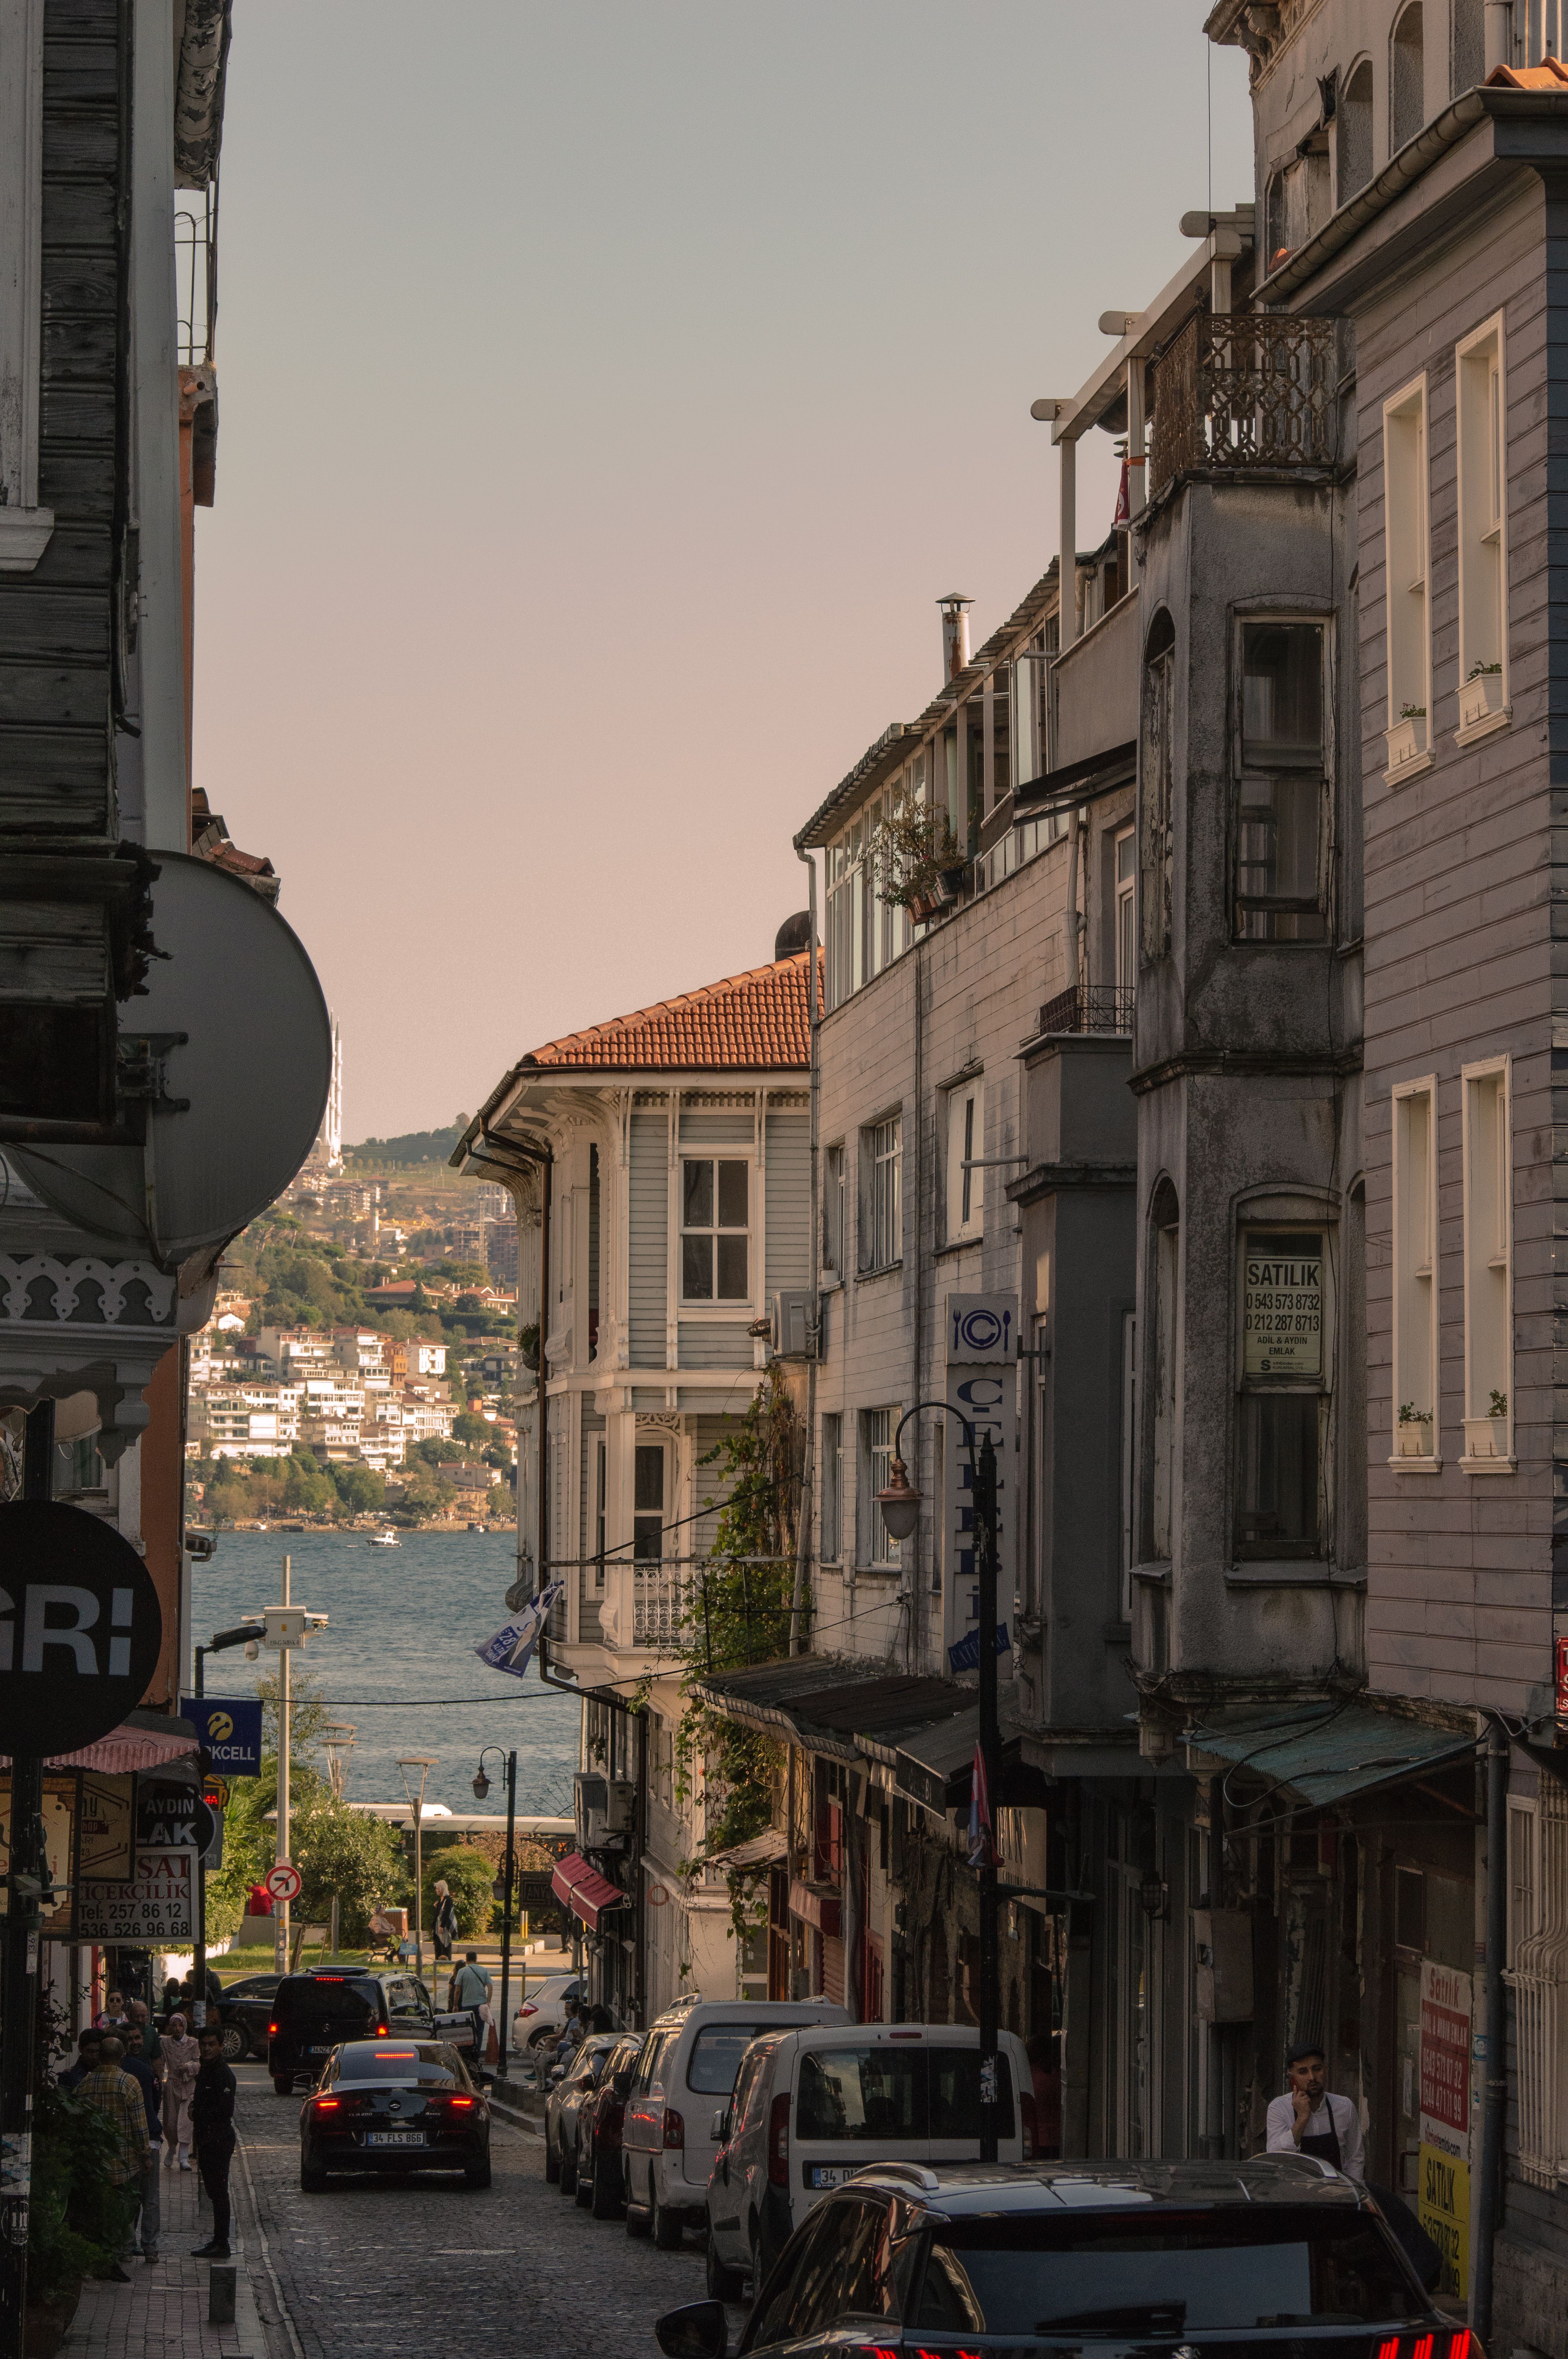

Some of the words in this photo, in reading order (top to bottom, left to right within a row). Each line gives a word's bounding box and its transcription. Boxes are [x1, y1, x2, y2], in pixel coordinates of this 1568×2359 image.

[1248, 1263, 1319, 1286] SATILIK
[1246, 1293, 1252, 1309] 0
[1255, 1293, 1273, 1309] 543
[1275, 1294, 1293, 1310] 573
[1296, 1294, 1319, 1310] 8732
[1246, 1314, 1252, 1330] 0
[1254, 1314, 1272, 1330] 212
[1275, 1314, 1293, 1331] 287
[1295, 1315, 1319, 1331] 8713
[1257, 1335, 1274, 1344] ADİL
[145, 1798, 194, 1814] AYDIN
[79, 1904, 103, 1920] Tel:
[109, 1904, 136, 1919] 257
[142, 1903, 160, 1918] 86
[165, 1903, 181, 1918] 12
[80, 1923, 108, 1937] 536
[114, 1923, 141, 1936] 526
[146, 1922, 165, 1936] 96
[171, 1921, 189, 1936] 68
[1423, 2046, 1435, 2075] 0543
[1436, 2052, 1446, 2082] 573
[1454, 2061, 1462, 2090] 32
[1454, 2094, 1461, 2123] 99
[374, 2134, 383, 2143] 34
[387, 2133, 403, 2143] FLS
[406, 2134, 421, 2143] 866
[822, 2170, 836, 2183] 34
[1426, 2157, 1455, 2215] SATILIK
